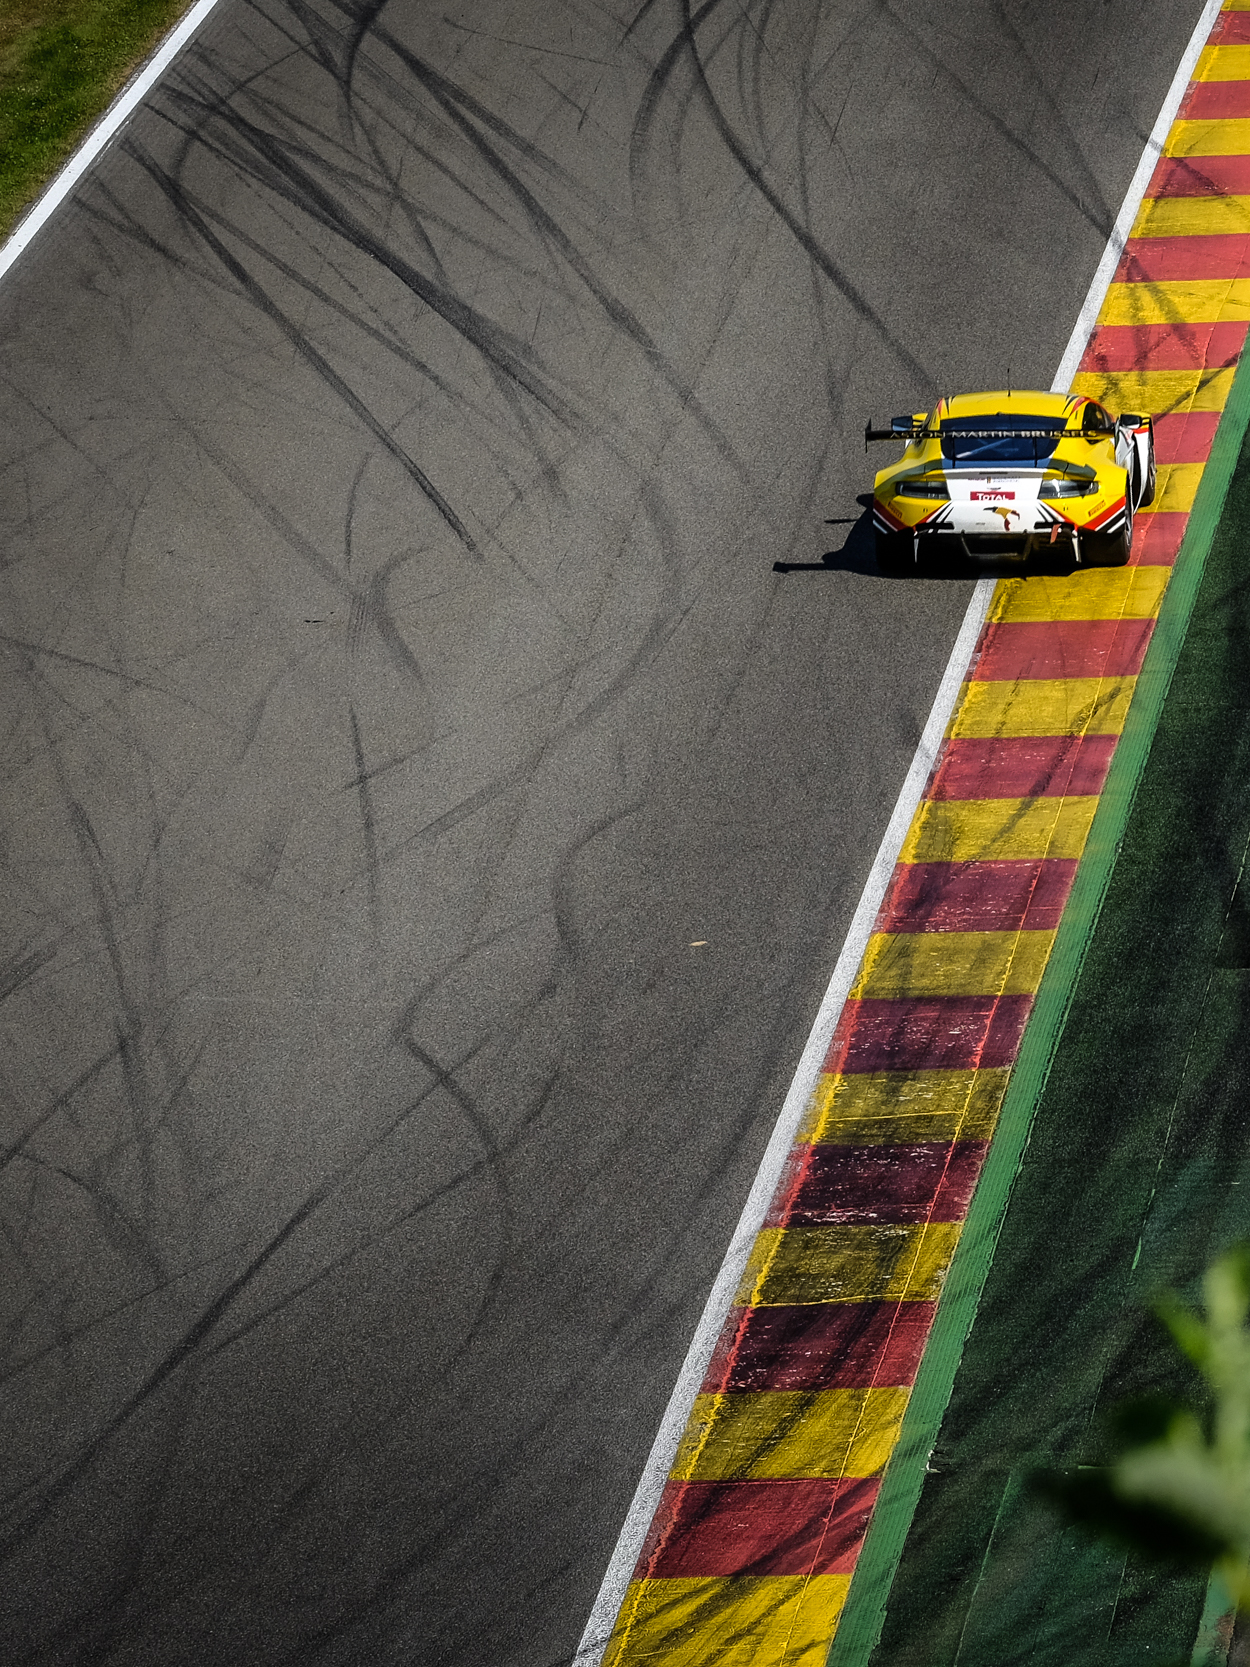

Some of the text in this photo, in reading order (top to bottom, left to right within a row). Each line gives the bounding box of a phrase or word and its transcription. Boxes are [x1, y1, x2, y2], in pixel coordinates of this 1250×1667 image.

[890, 430, 1097, 439] ASTON MARTIN BRUSSELS
[976, 492, 1010, 501] TOTAL
